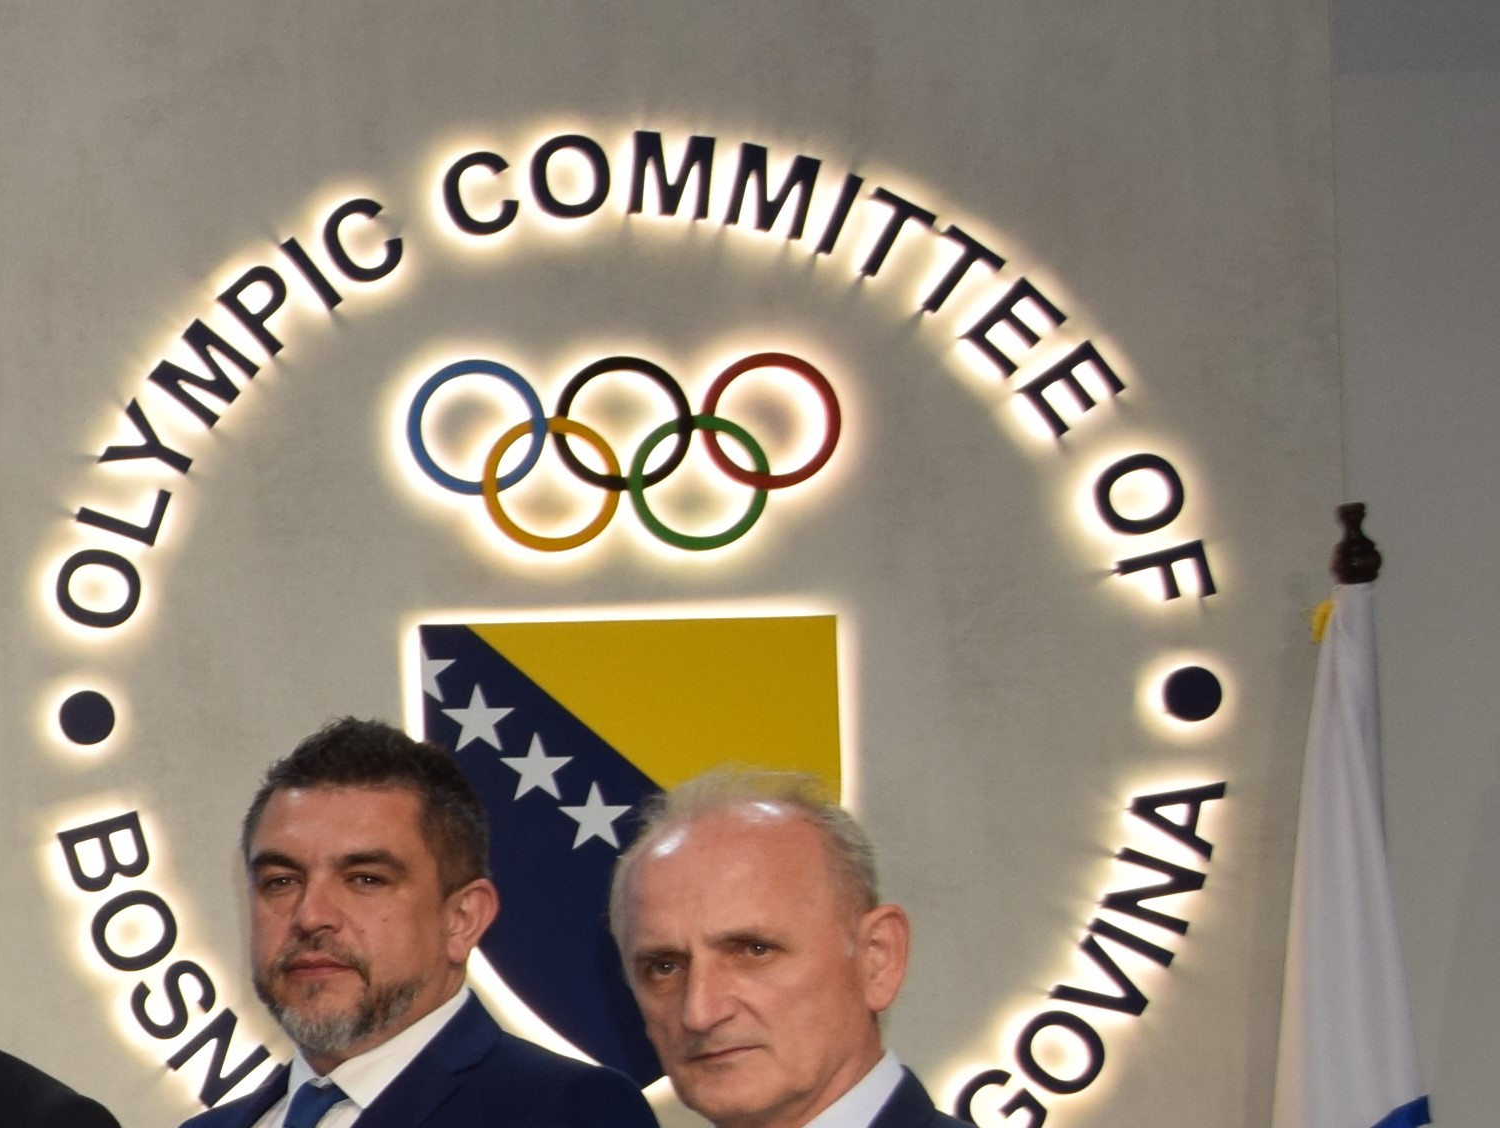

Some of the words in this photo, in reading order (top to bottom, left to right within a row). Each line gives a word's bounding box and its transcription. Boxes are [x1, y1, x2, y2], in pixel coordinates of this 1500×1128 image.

[56, 198, 404, 629] OLYMPIC
[442, 130, 1128, 440] COMMITTEE
[1094, 453, 1218, 602] OF
[57, 809, 285, 1109] BOSN
